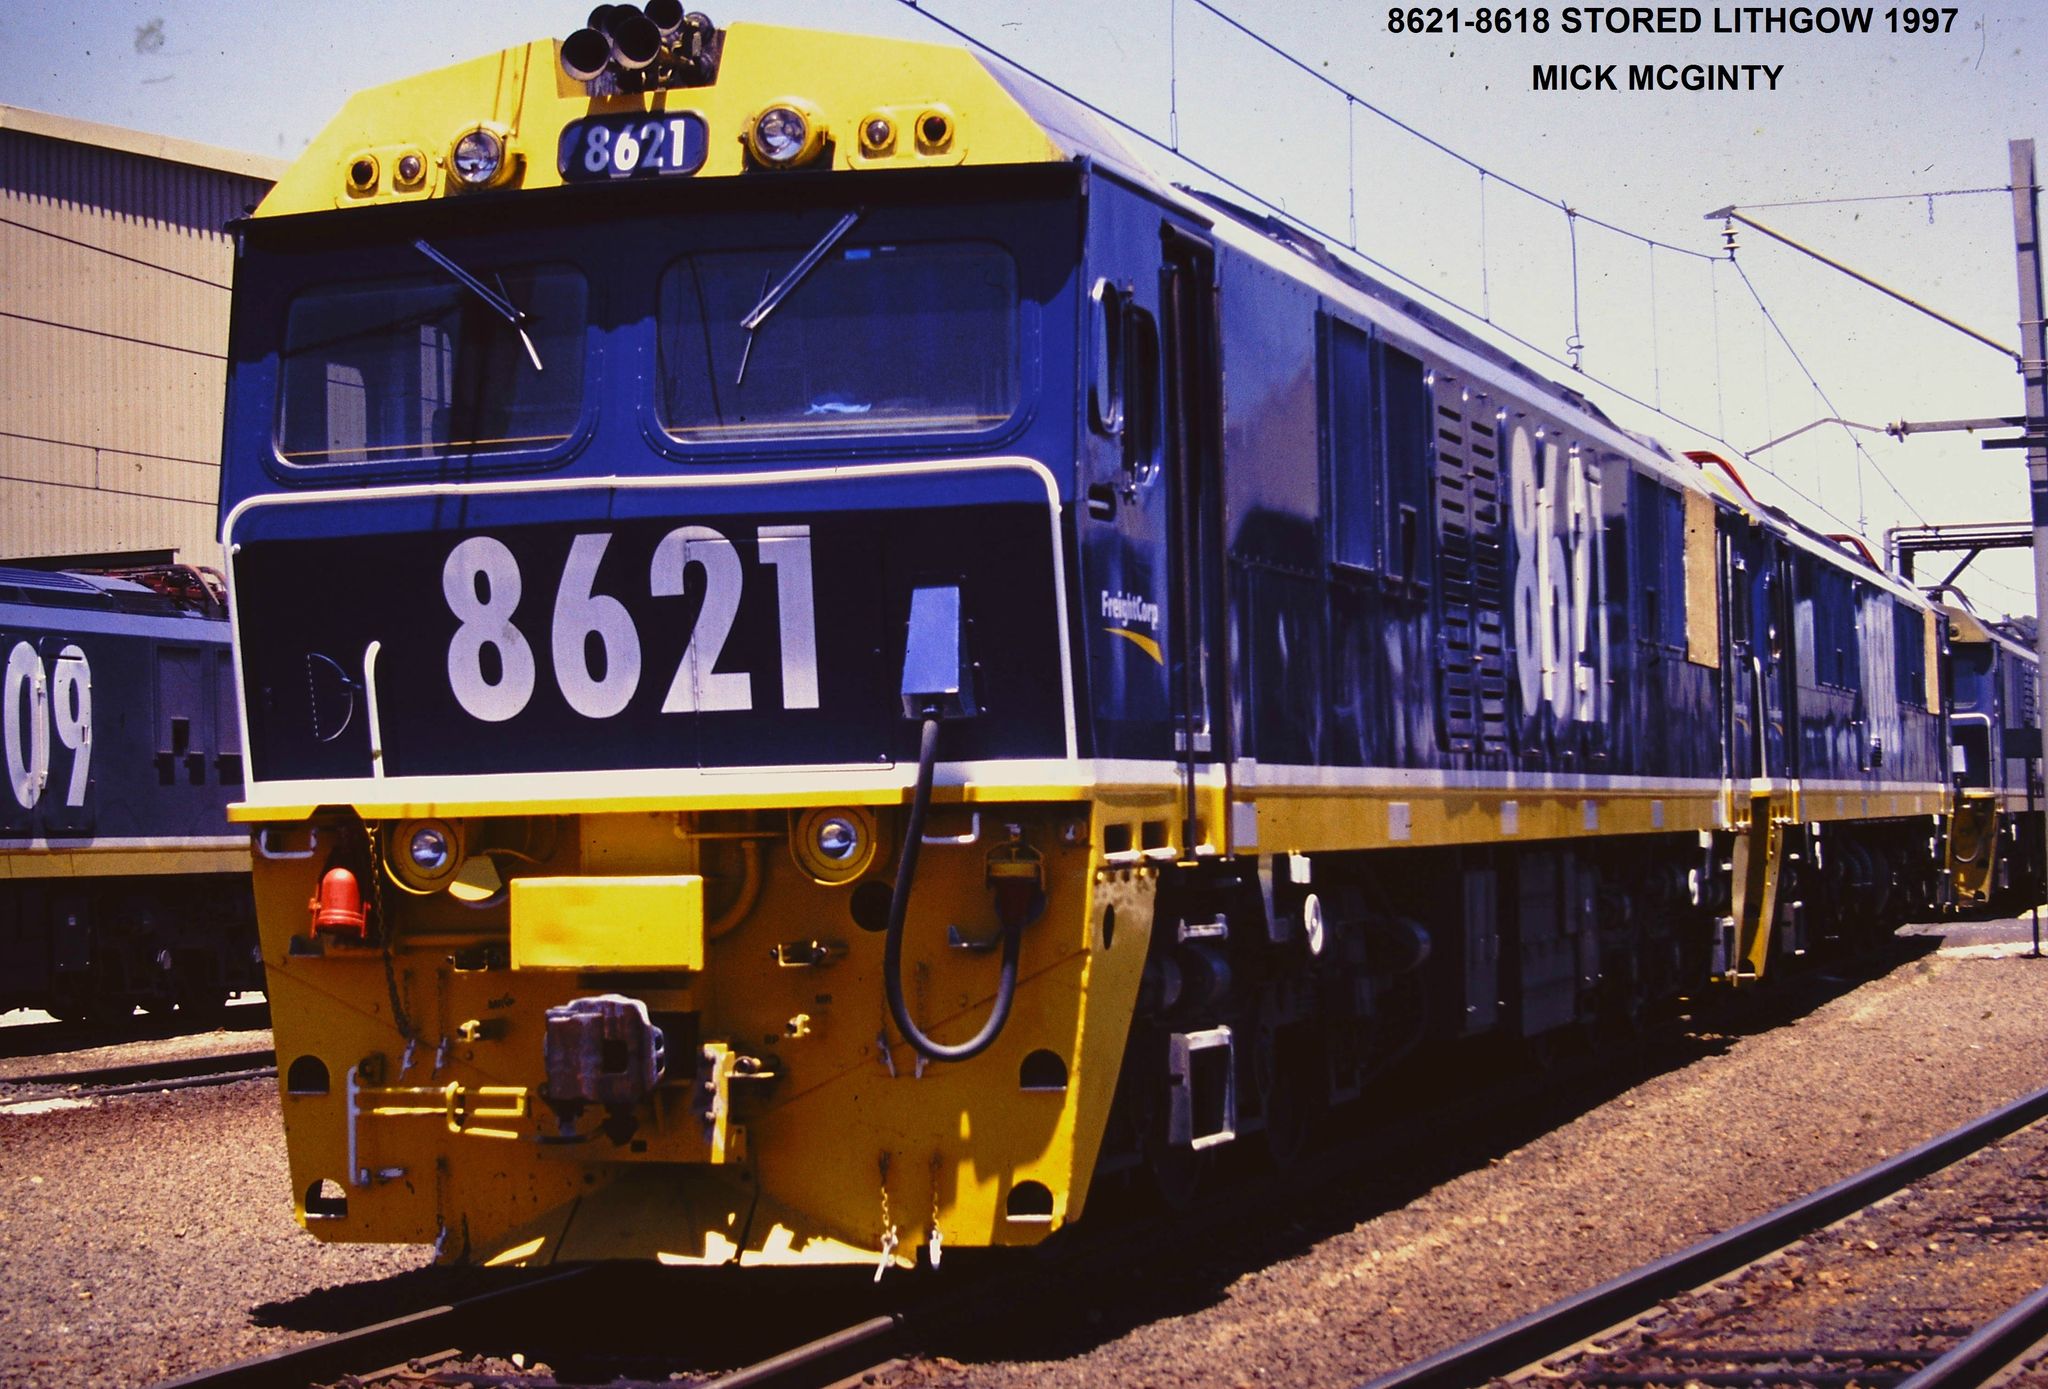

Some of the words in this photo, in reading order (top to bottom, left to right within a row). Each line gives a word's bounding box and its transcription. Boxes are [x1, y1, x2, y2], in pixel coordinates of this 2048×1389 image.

[584, 119, 686, 173] 8621
[442, 525, 820, 722] 8621
[1101, 590, 1159, 631] FreightCorp
[1511, 426, 1609, 724] 8621
[4, 640, 92, 810] 09
